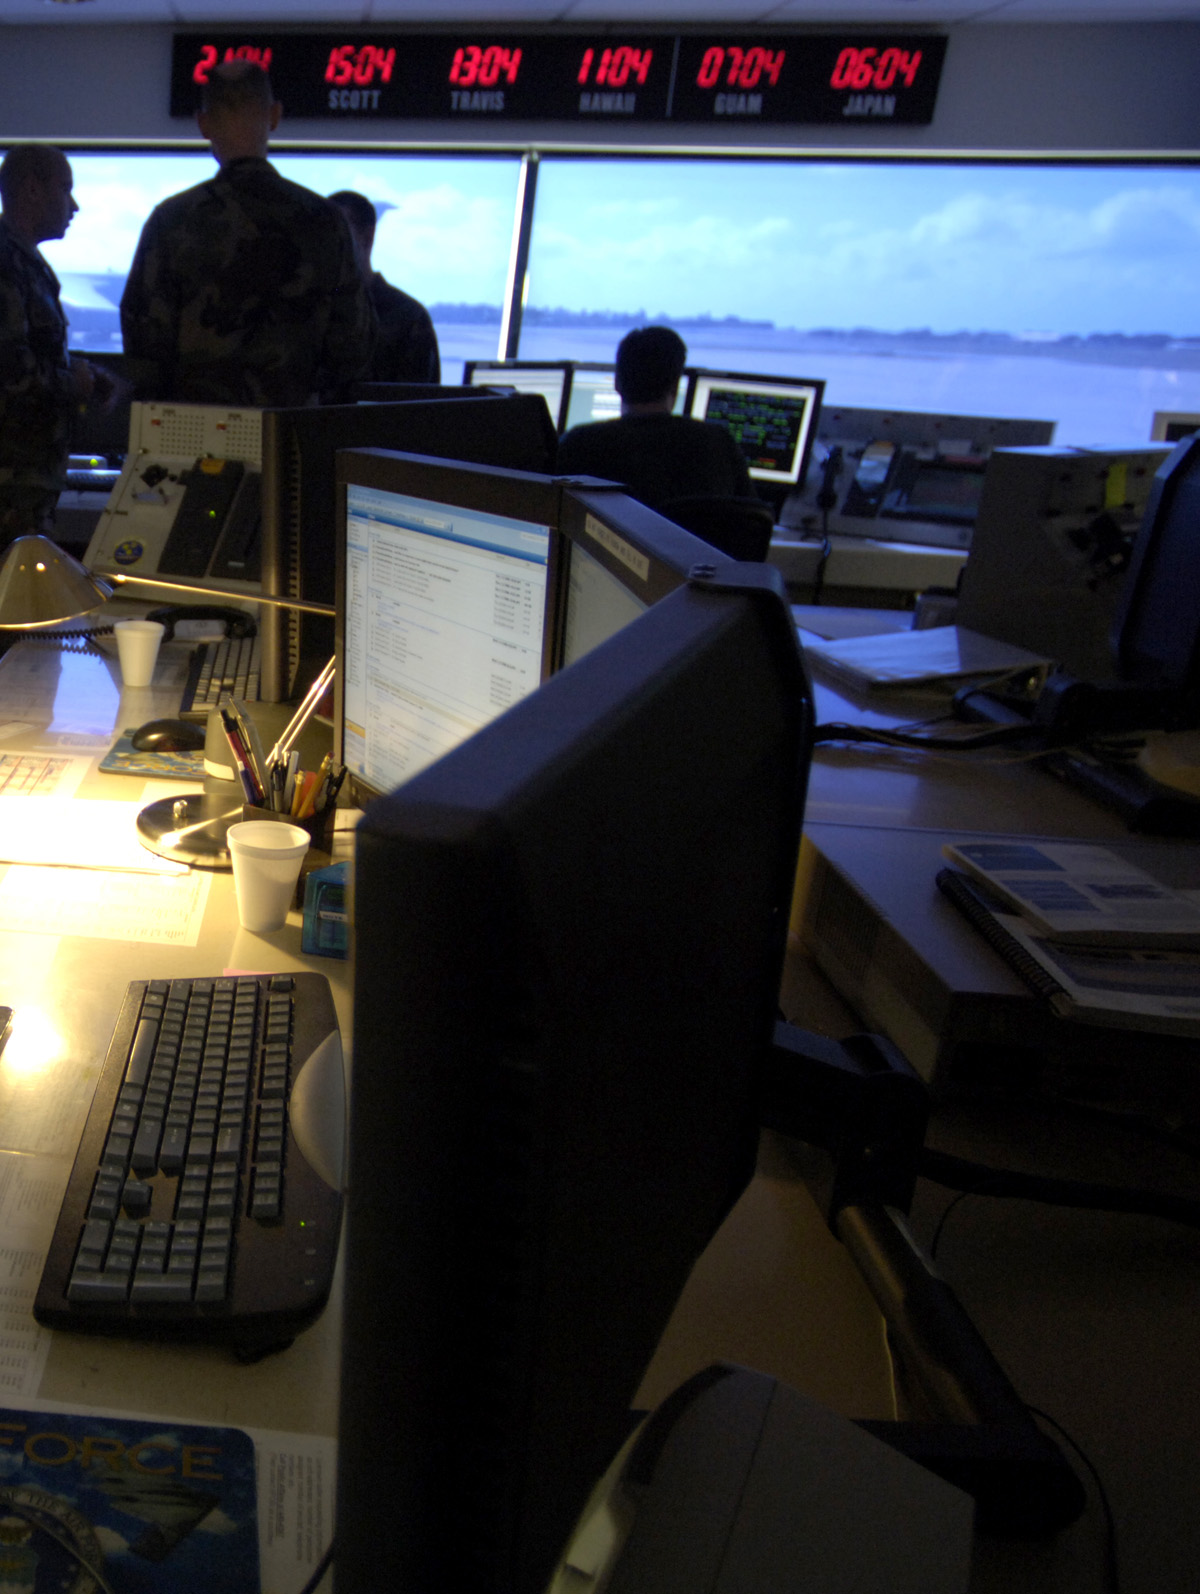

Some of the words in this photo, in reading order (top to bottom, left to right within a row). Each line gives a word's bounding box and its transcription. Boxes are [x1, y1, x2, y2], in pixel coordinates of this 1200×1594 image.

[328, 90, 381, 110] SCOTT
[450, 90, 505, 112] TRAVIS
[842, 94, 897, 116] JAPAN
